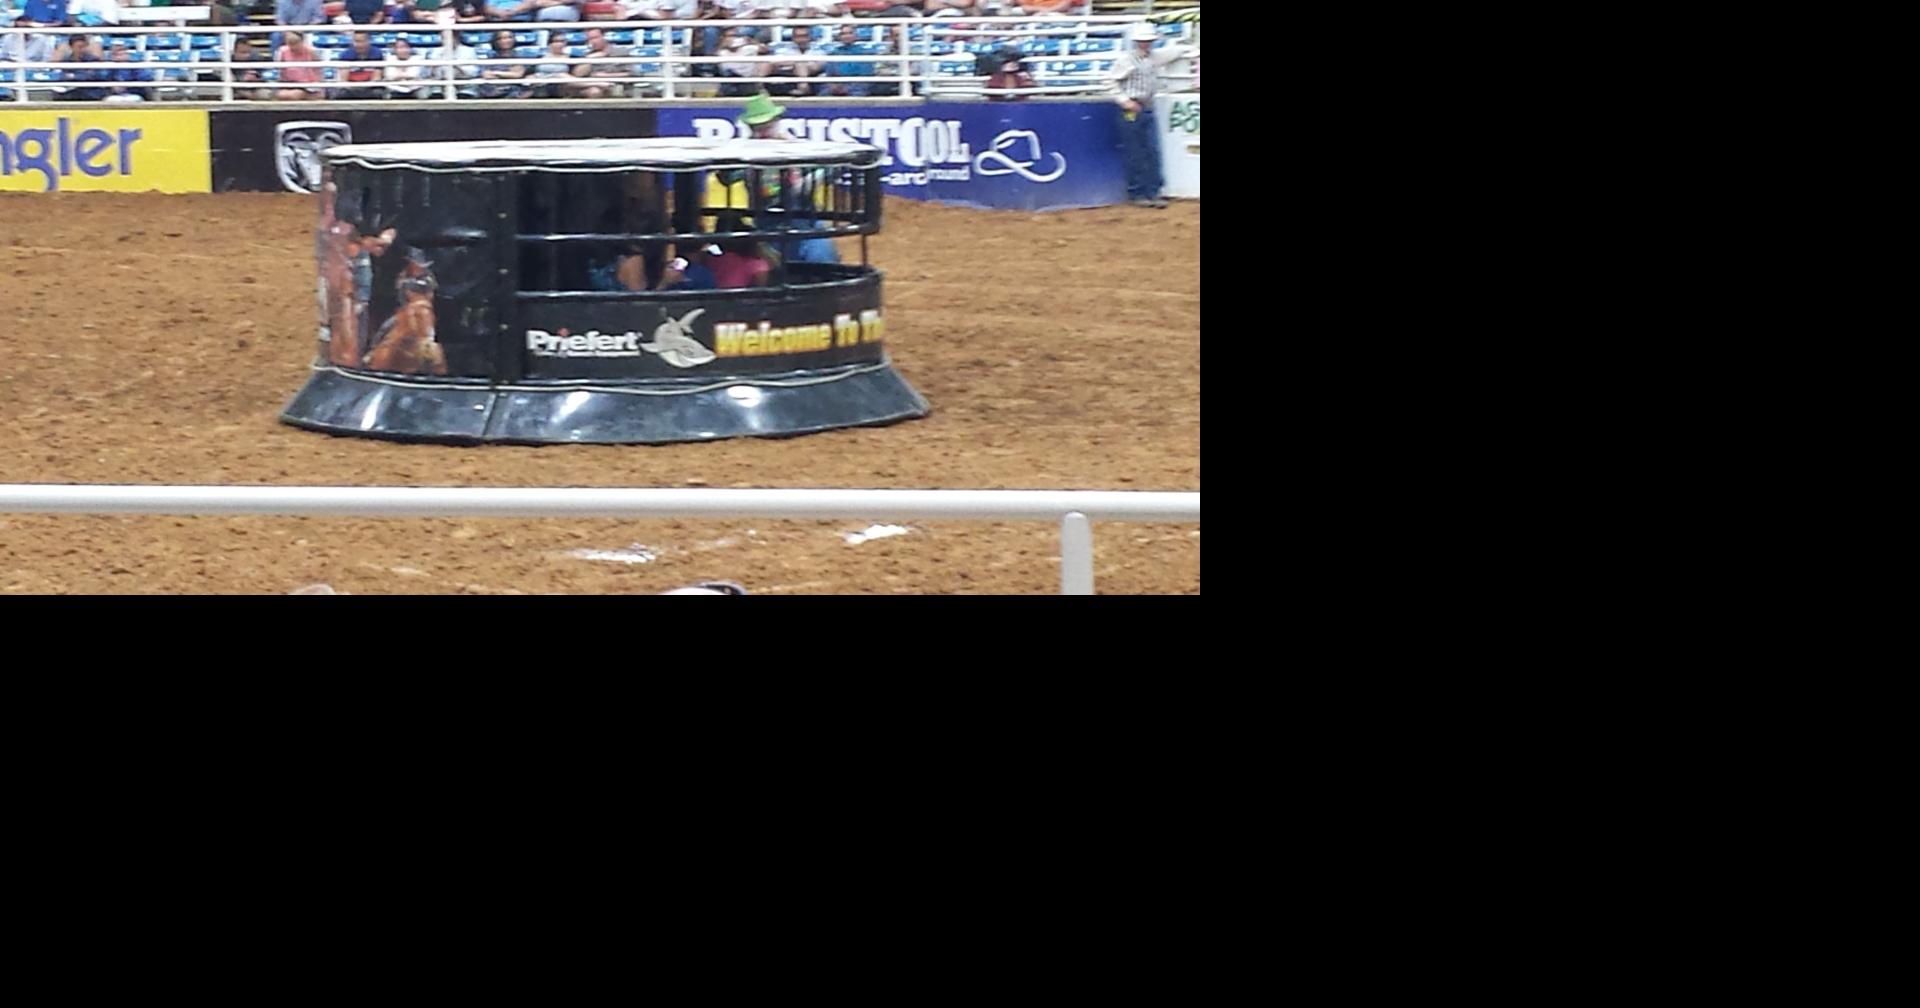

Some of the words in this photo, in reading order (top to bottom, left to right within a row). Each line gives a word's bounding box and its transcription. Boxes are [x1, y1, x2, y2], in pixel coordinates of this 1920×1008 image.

[526, 327, 639, 351] Priefert
[714, 321, 832, 357] Welcome
[834, 313, 859, 348] To
